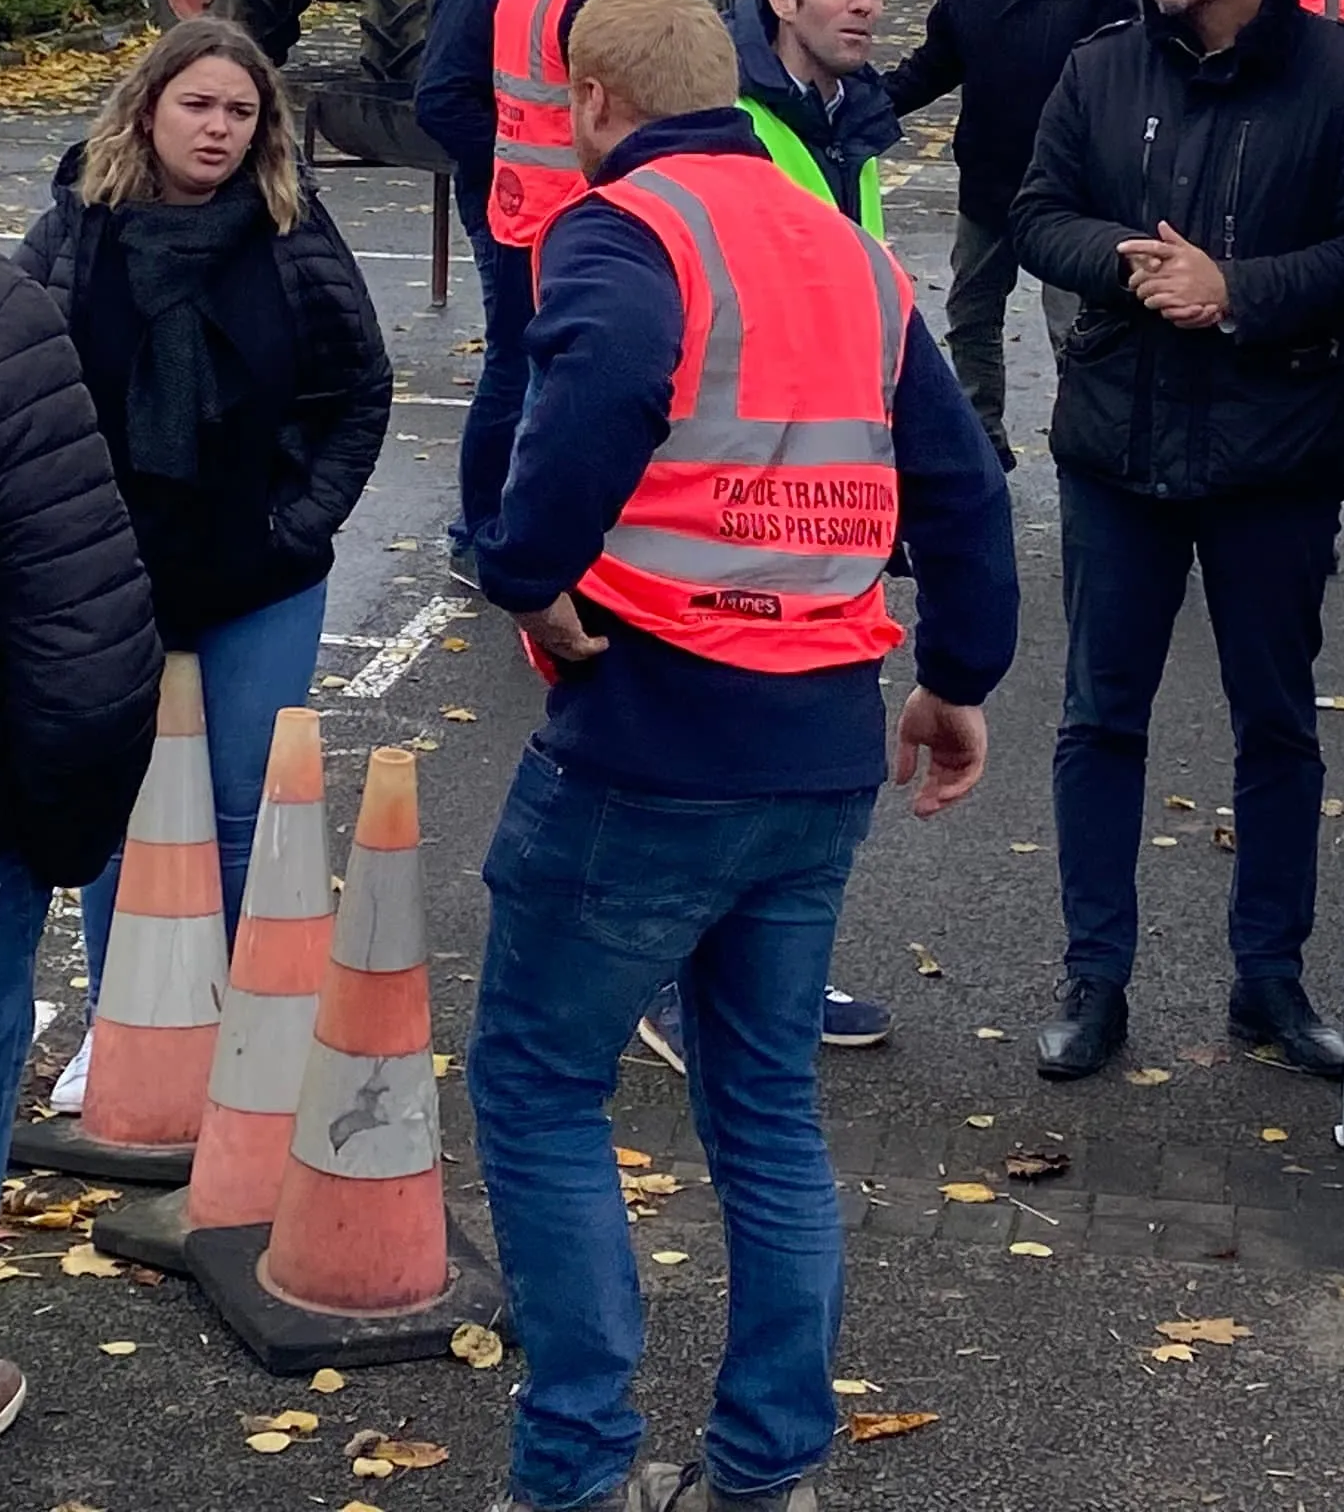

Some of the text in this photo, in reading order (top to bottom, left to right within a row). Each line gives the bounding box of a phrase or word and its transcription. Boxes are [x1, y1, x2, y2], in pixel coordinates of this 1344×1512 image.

[754, 477, 781, 507] DE
[782, 480, 896, 513] TRANSITION
[719, 510, 782, 541] SOUS
[785, 514, 883, 548] PRESSION
